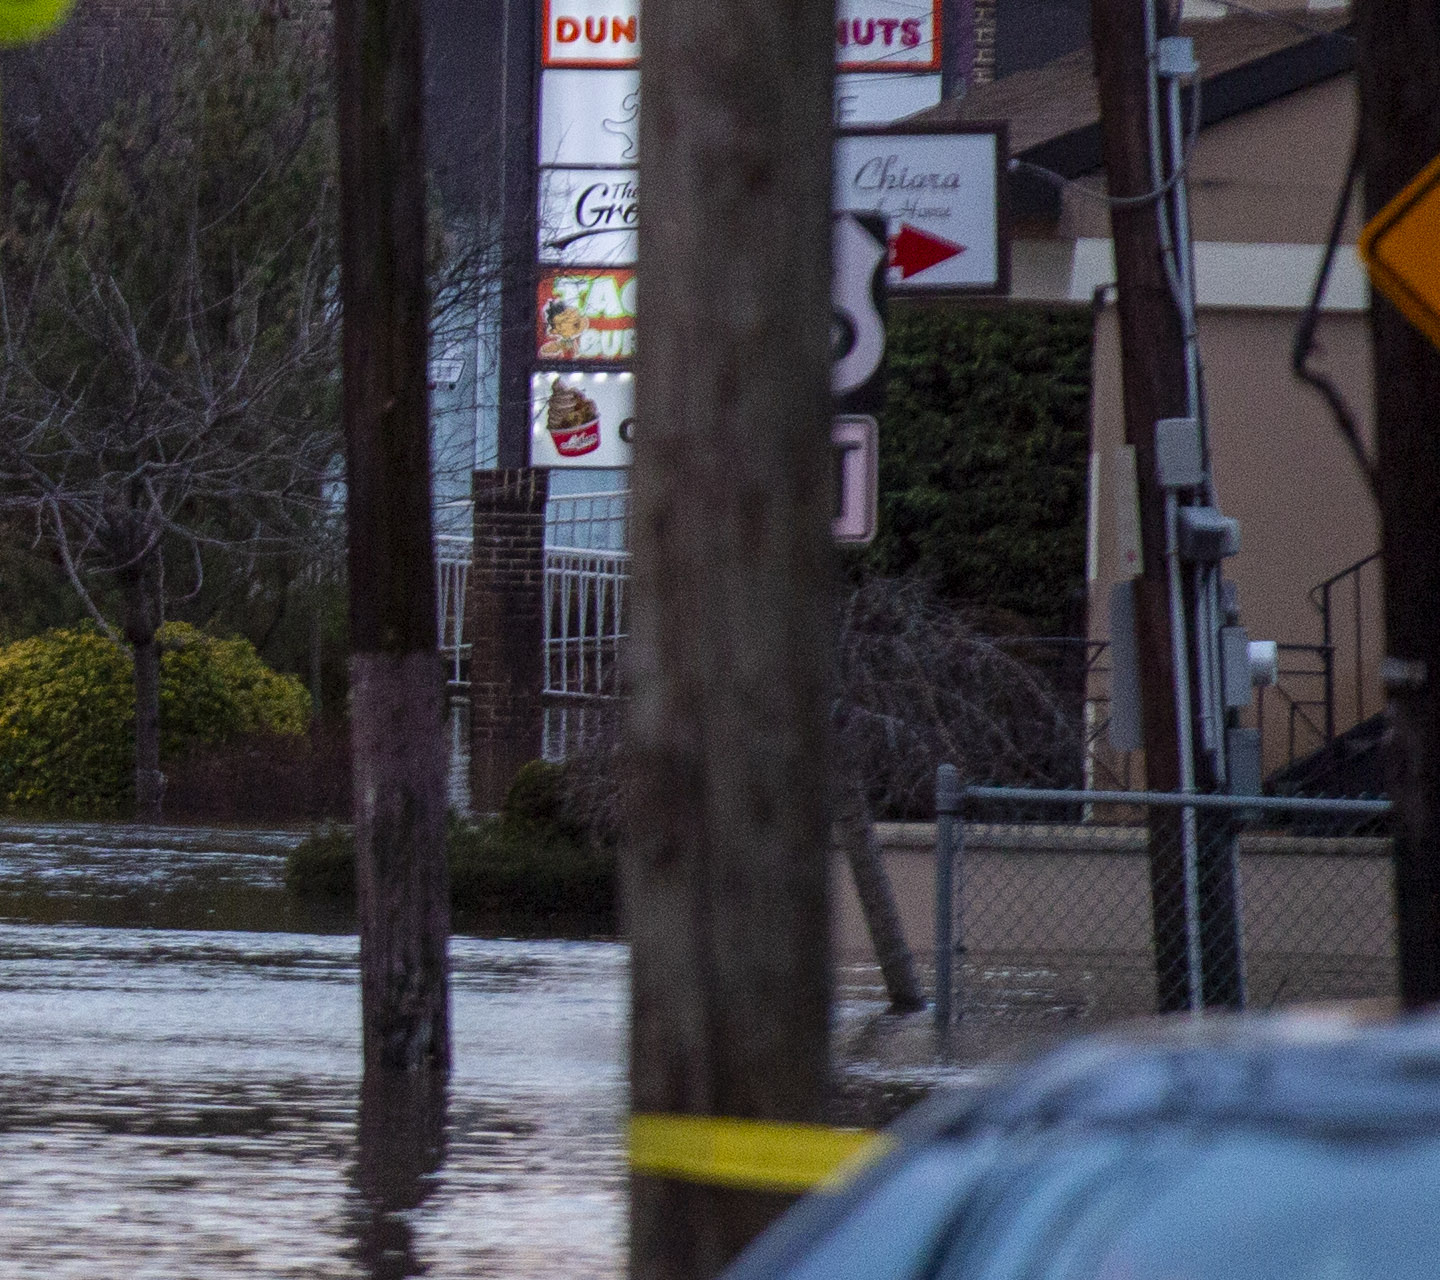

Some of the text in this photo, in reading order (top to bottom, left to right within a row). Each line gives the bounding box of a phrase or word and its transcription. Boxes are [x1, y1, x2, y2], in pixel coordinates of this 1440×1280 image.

[556, 15, 922, 47] DUN UTS
[854, 154, 961, 190] Chiara
[576, 182, 639, 228] Gre
